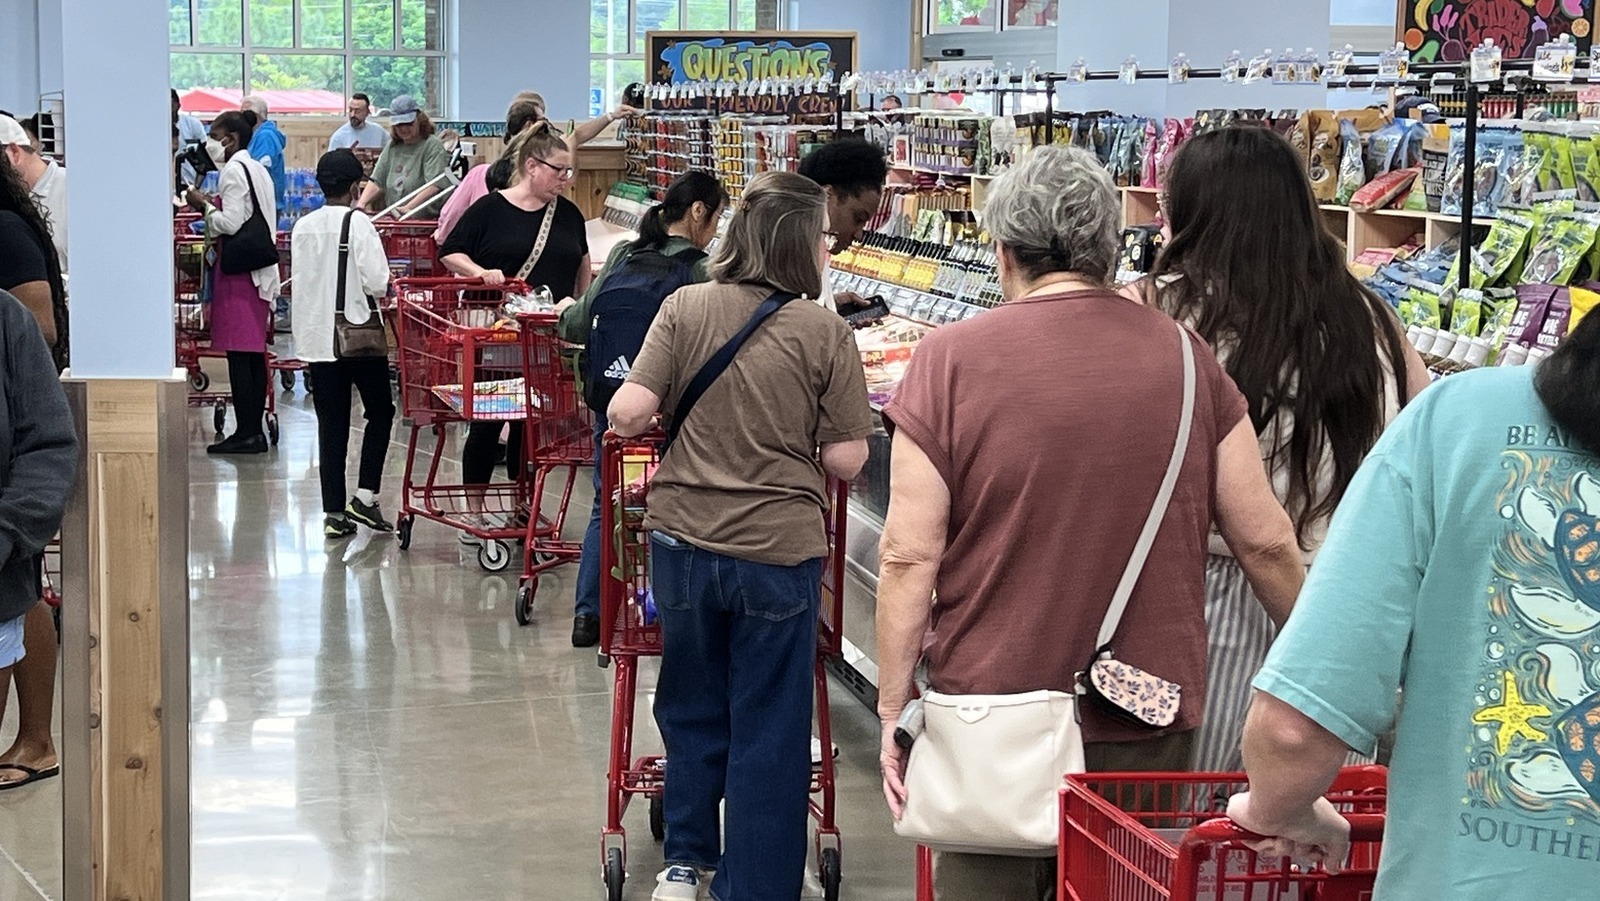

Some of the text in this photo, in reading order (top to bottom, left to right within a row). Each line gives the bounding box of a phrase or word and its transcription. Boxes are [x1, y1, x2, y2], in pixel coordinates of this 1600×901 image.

[681, 43, 830, 83] QUESTIONS
[705, 93, 791, 113] FRIENDLY
[1507, 424, 1538, 446] BE
[1457, 812, 1600, 862] SOUTHE
